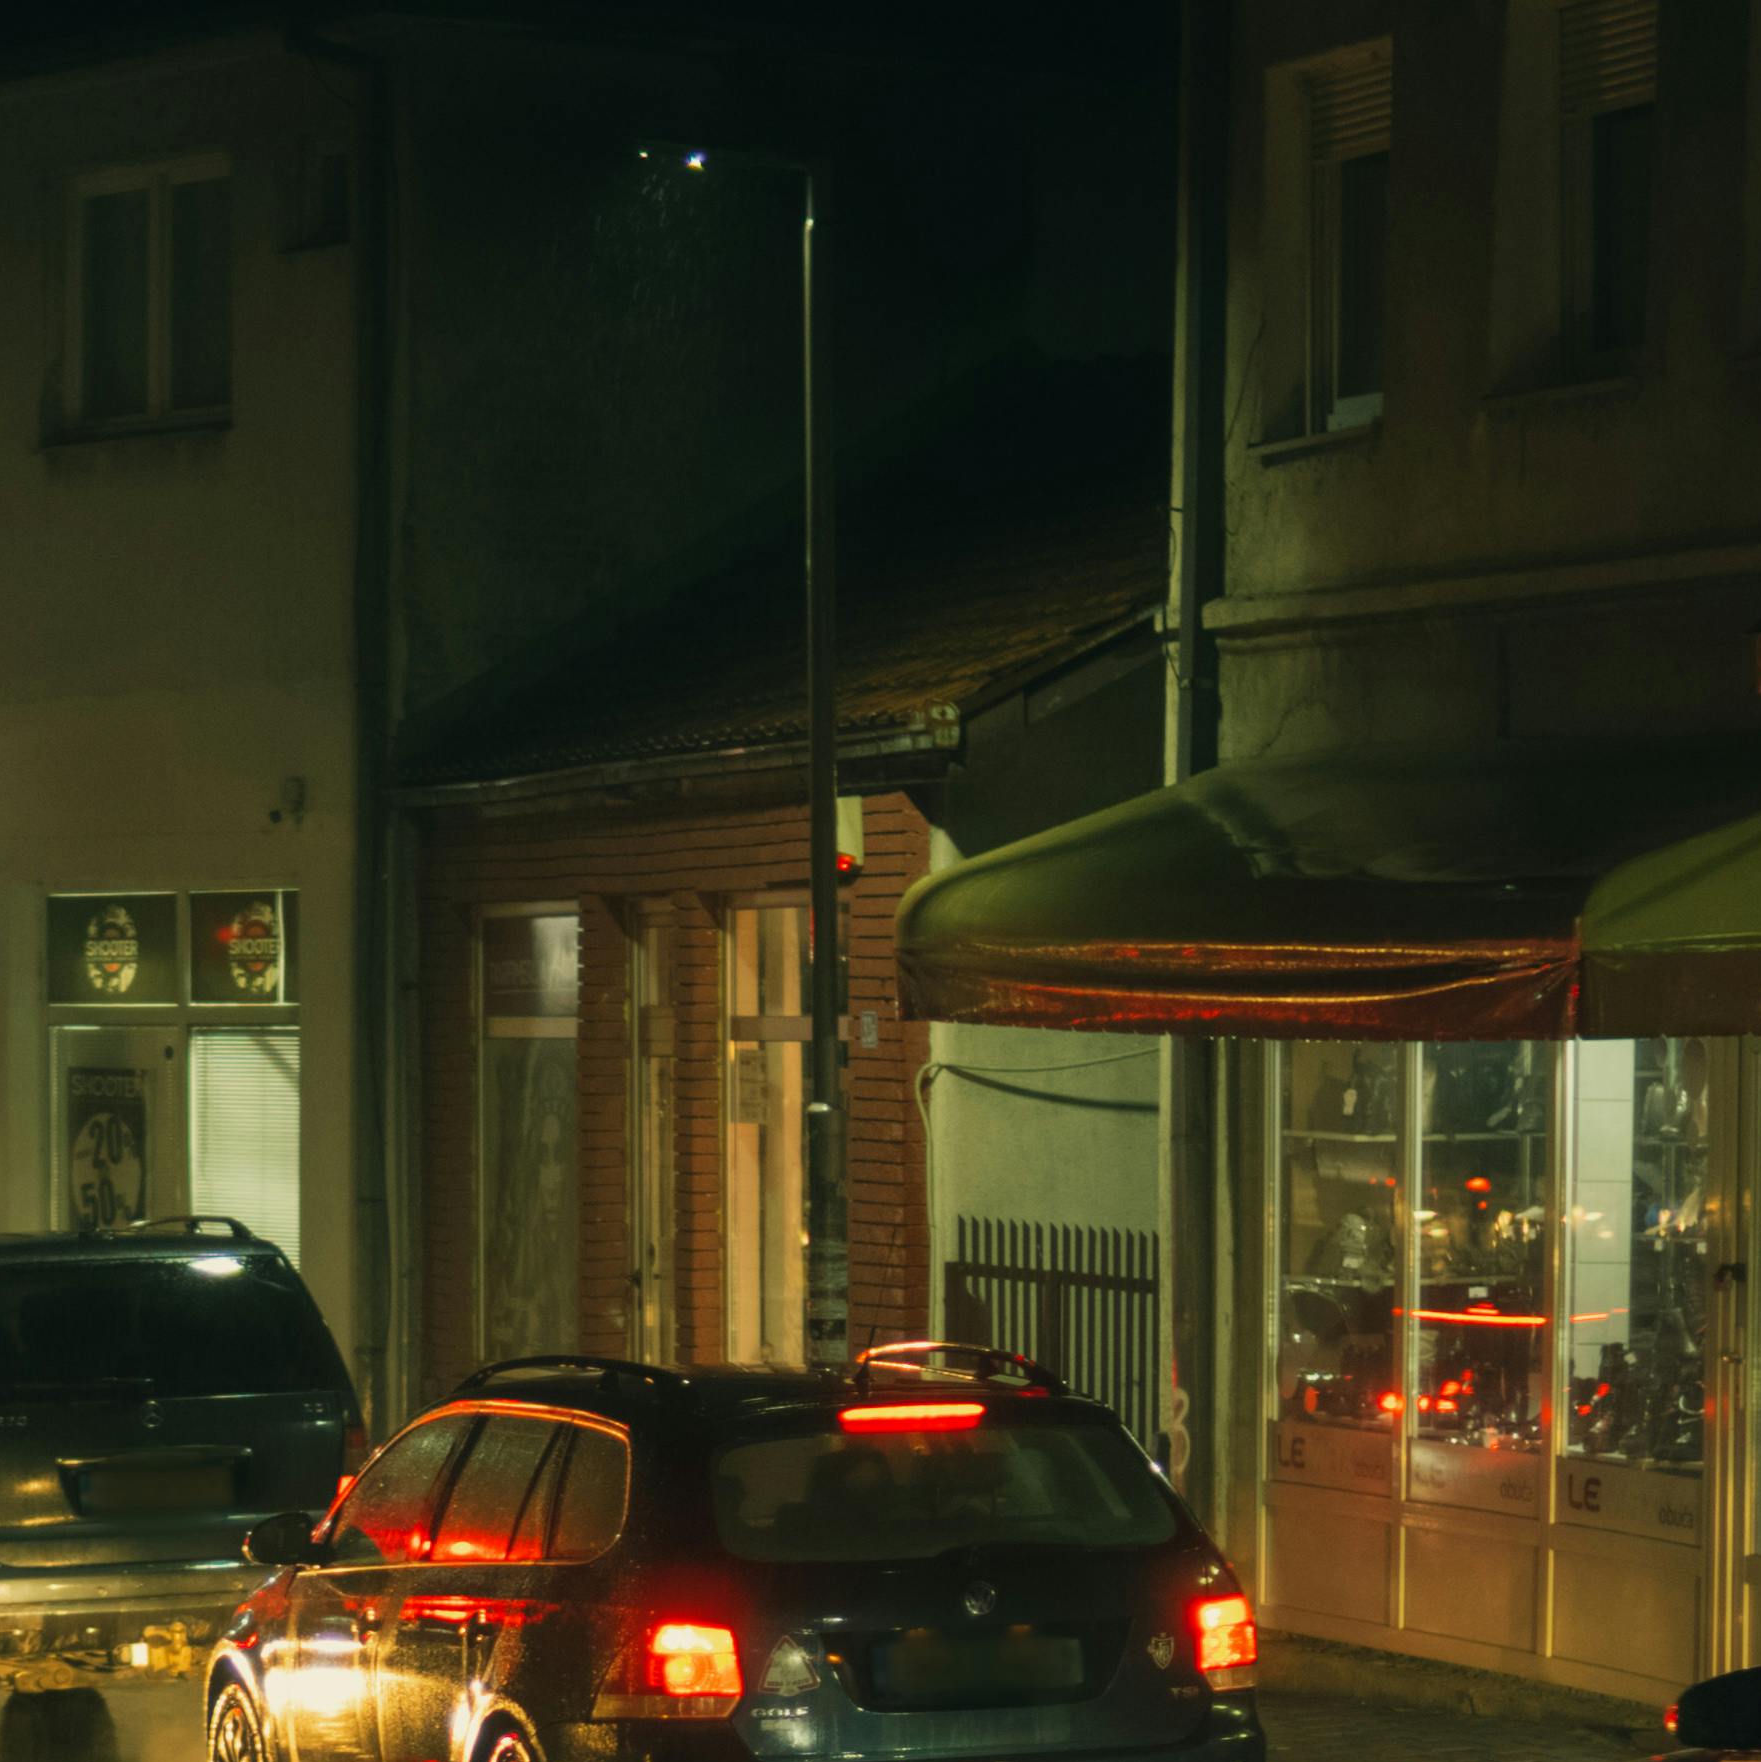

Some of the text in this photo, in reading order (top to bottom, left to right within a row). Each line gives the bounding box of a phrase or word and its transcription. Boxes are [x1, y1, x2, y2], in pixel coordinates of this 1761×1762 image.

[85, 939, 139, 957] SHOOTER
[1277, 1434, 1305, 1470] LE
[1567, 1473, 1602, 1512] LE
[750, 1706, 810, 1718] GOLF
